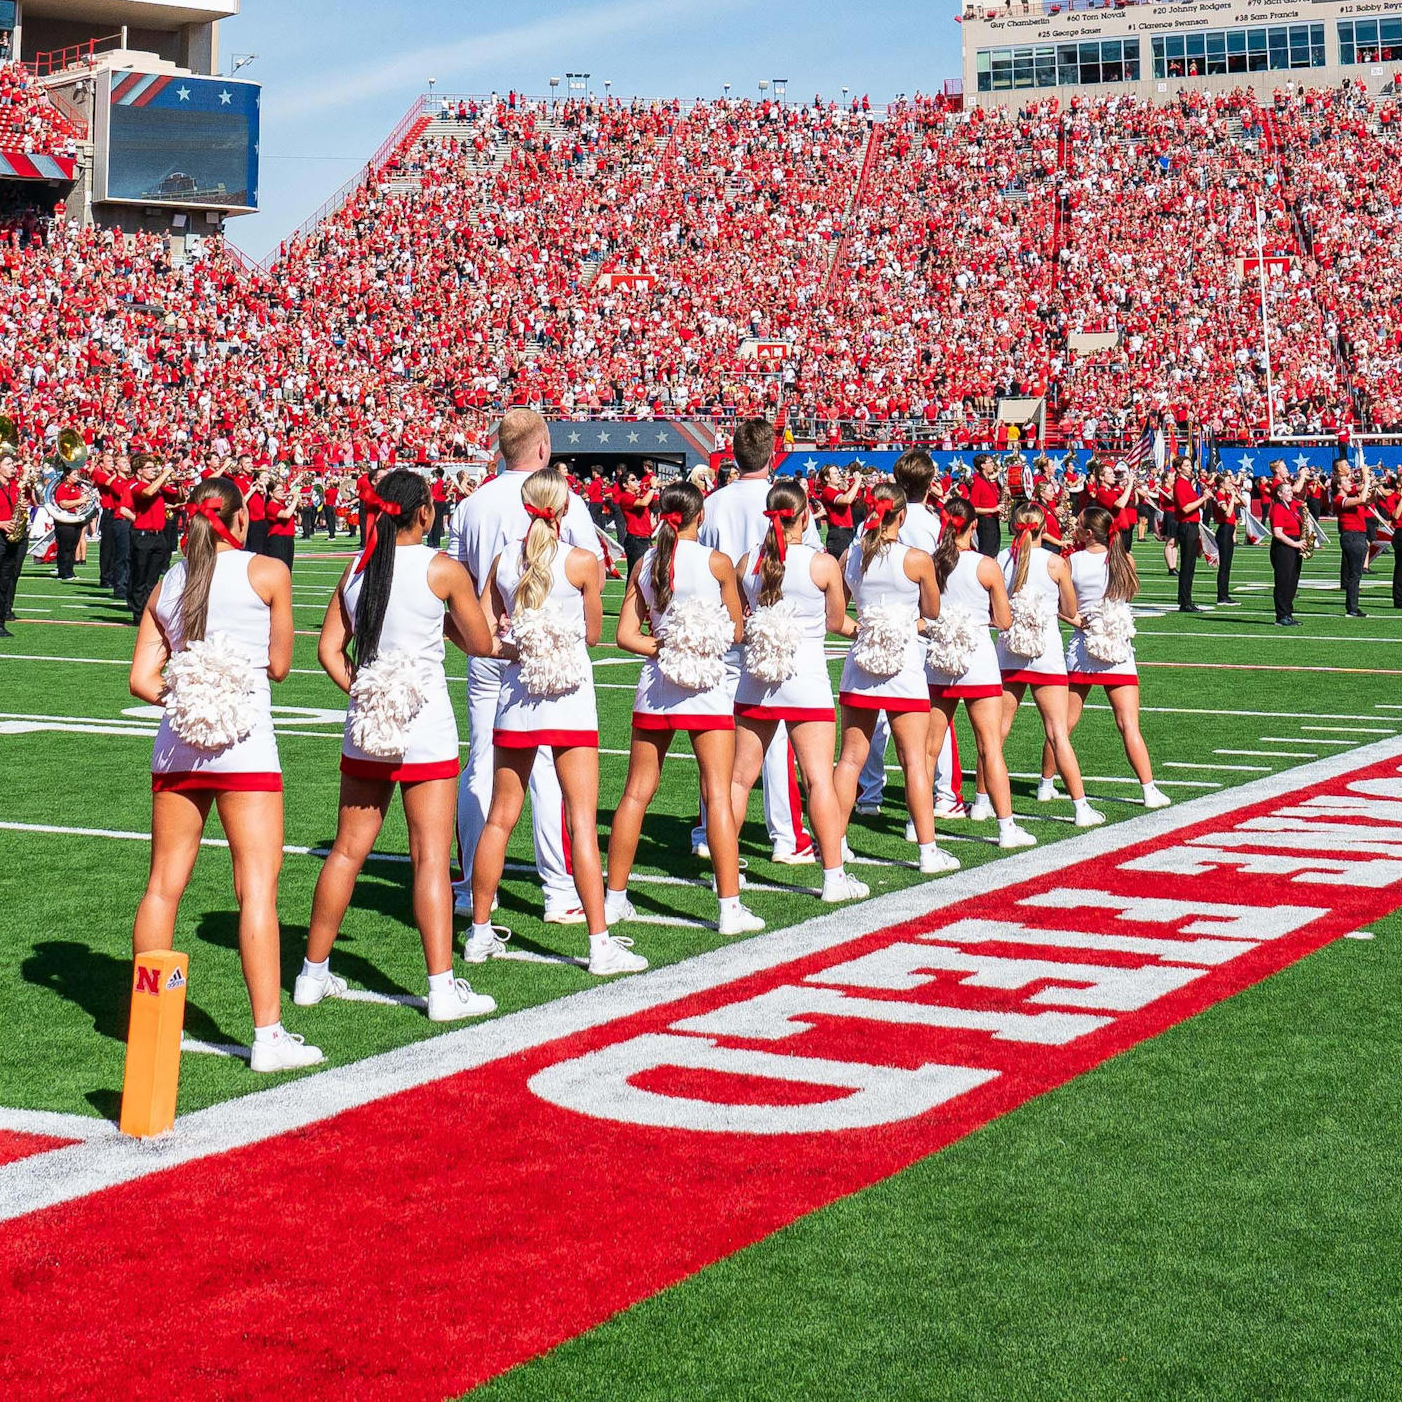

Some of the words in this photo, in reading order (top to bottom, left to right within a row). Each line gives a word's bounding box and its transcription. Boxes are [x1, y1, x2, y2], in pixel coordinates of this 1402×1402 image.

[1152, 6, 1167, 15] #20
[1168, 4, 1198, 14] Johnny
[1199, 1, 1232, 12] Rodgers
[1340, 4, 1354, 14] #12
[1356, 2, 1381, 13] Bobby
[1066, 13, 1080, 22] #60
[1082, 13, 1099, 21] Tom
[1101, 11, 1127, 20] Novak
[1234, 14, 1249, 22] #38
[1250, 12, 1268, 21] Sam
[1270, 10, 1299, 19] Francis
[990, 20, 1005, 29] Guy
[1007, 18, 1050, 28] Chamberlin
[1128, 22, 1136, 31] #1
[1138, 20, 1173, 30] Clarence
[1174, 17, 1209, 27] Swanson
[1037, 30, 1051, 38] #25
[1052, 29, 1079, 38] George
[1080, 27, 1102, 36] Sauer
[1270, 263, 1283, 277] N
[136, 965, 160, 997] N
[528, 887, 1332, 1135] FIELD
